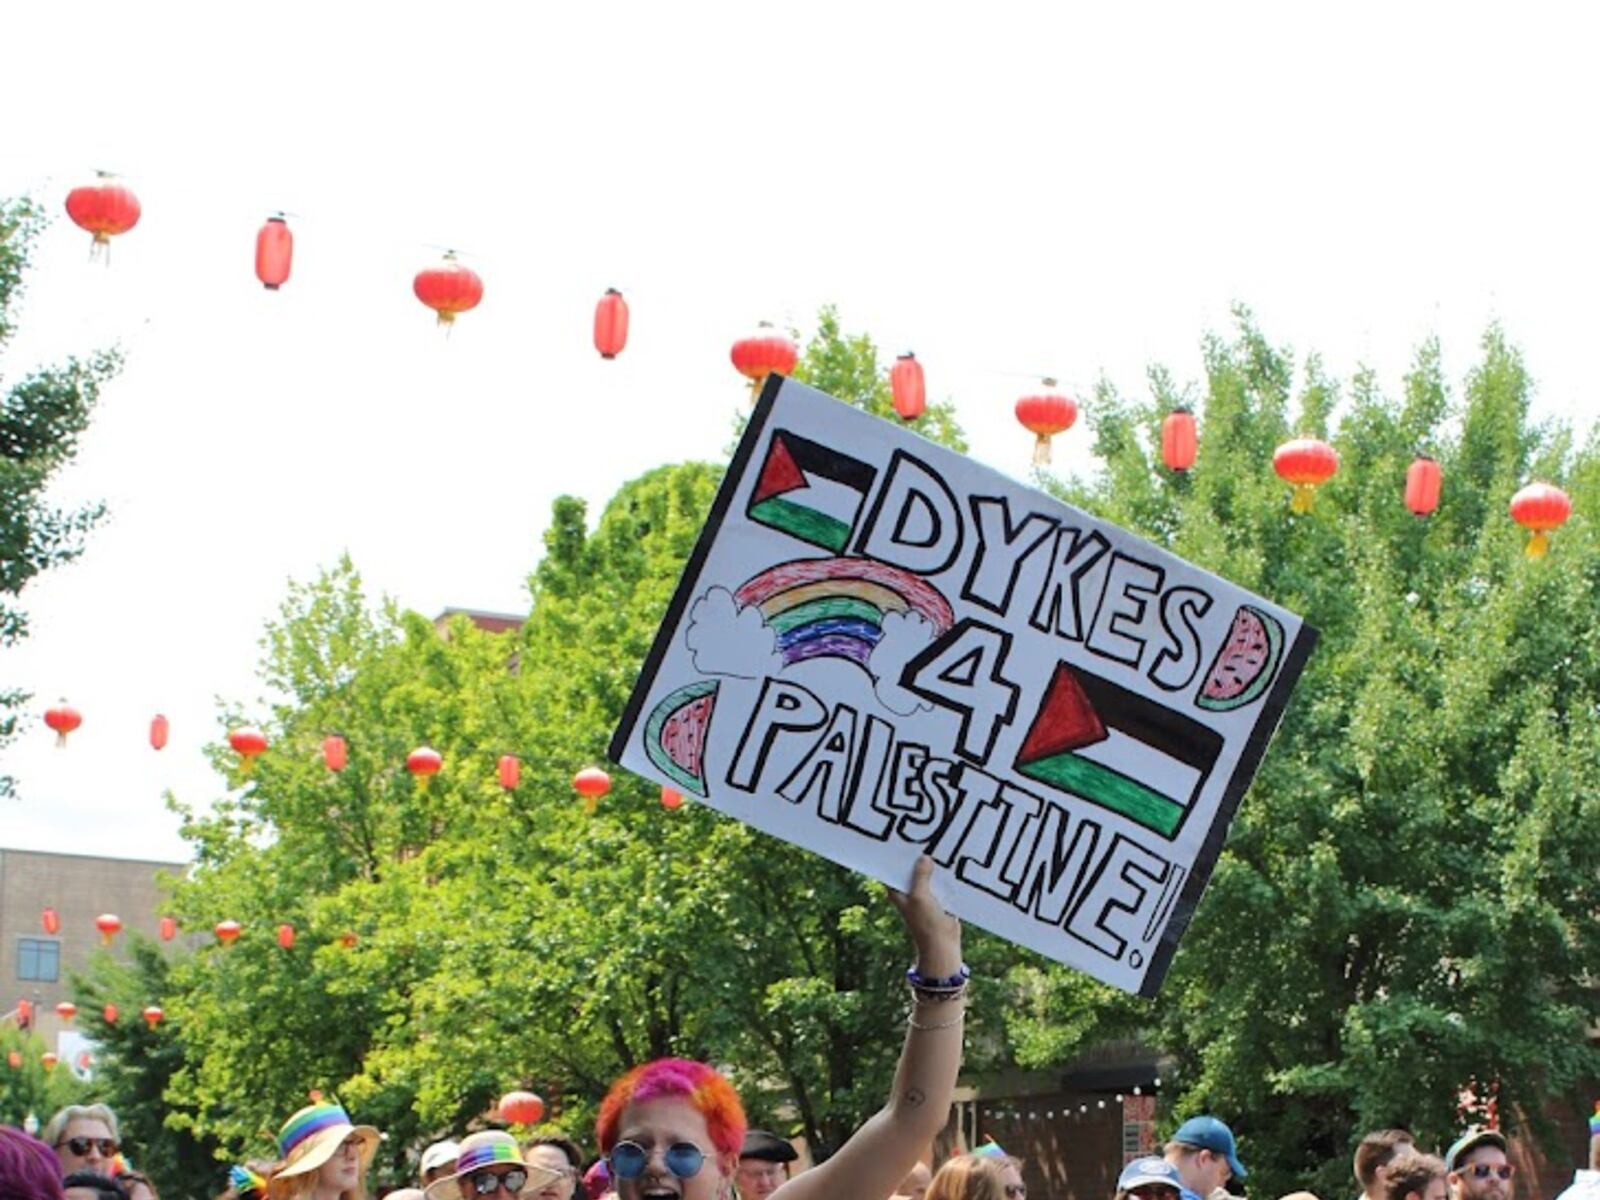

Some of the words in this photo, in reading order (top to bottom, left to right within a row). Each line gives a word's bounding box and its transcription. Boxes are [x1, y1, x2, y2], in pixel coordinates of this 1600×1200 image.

[854, 448, 1213, 691] DYKES
[899, 617, 1019, 766] 4
[725, 676, 1187, 970] PALESTINE!
